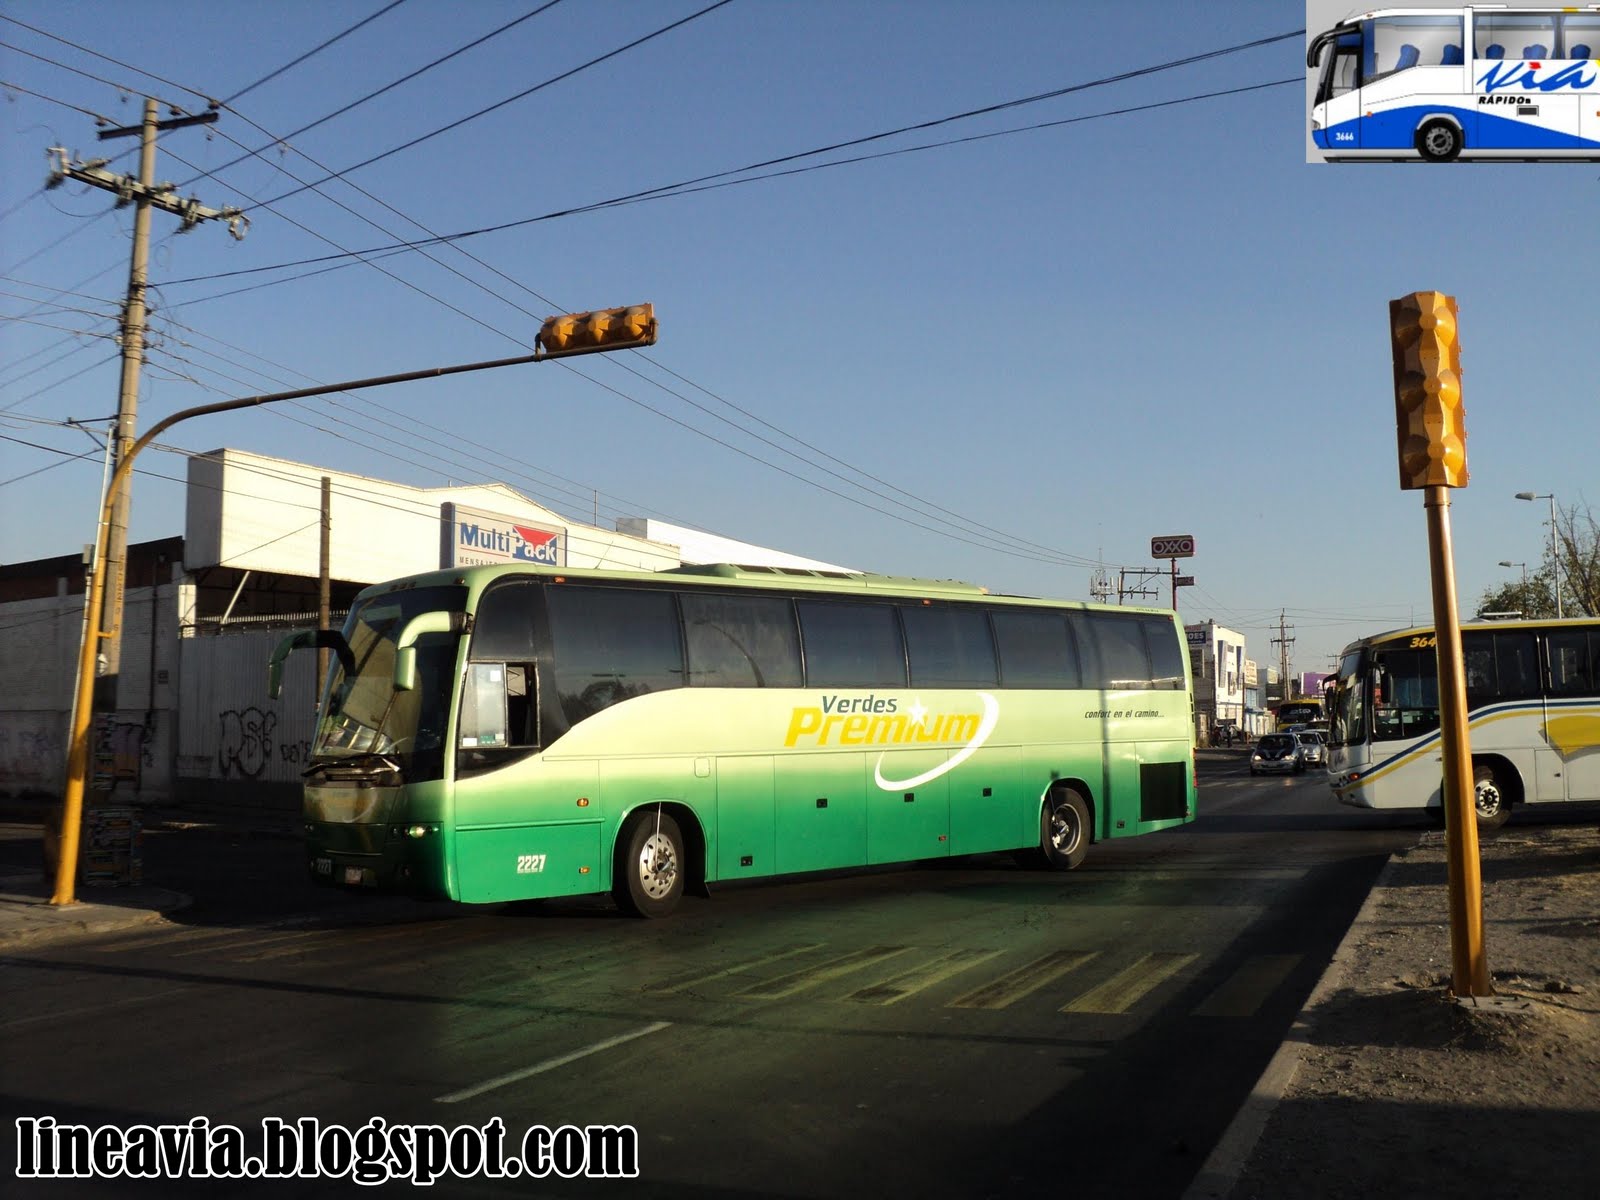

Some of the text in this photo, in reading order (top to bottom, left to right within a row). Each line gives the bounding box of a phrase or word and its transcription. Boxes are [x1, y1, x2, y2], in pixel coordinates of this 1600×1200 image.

[1152, 540, 1192, 554] OXXO
[822, 695, 897, 714] Verdes
[1084, 709, 1112, 719] confort
[1113, 710, 1123, 718] en
[1125, 710, 1133, 718] el
[784, 706, 980, 747] Premium
[517, 854, 547, 874] 2227
